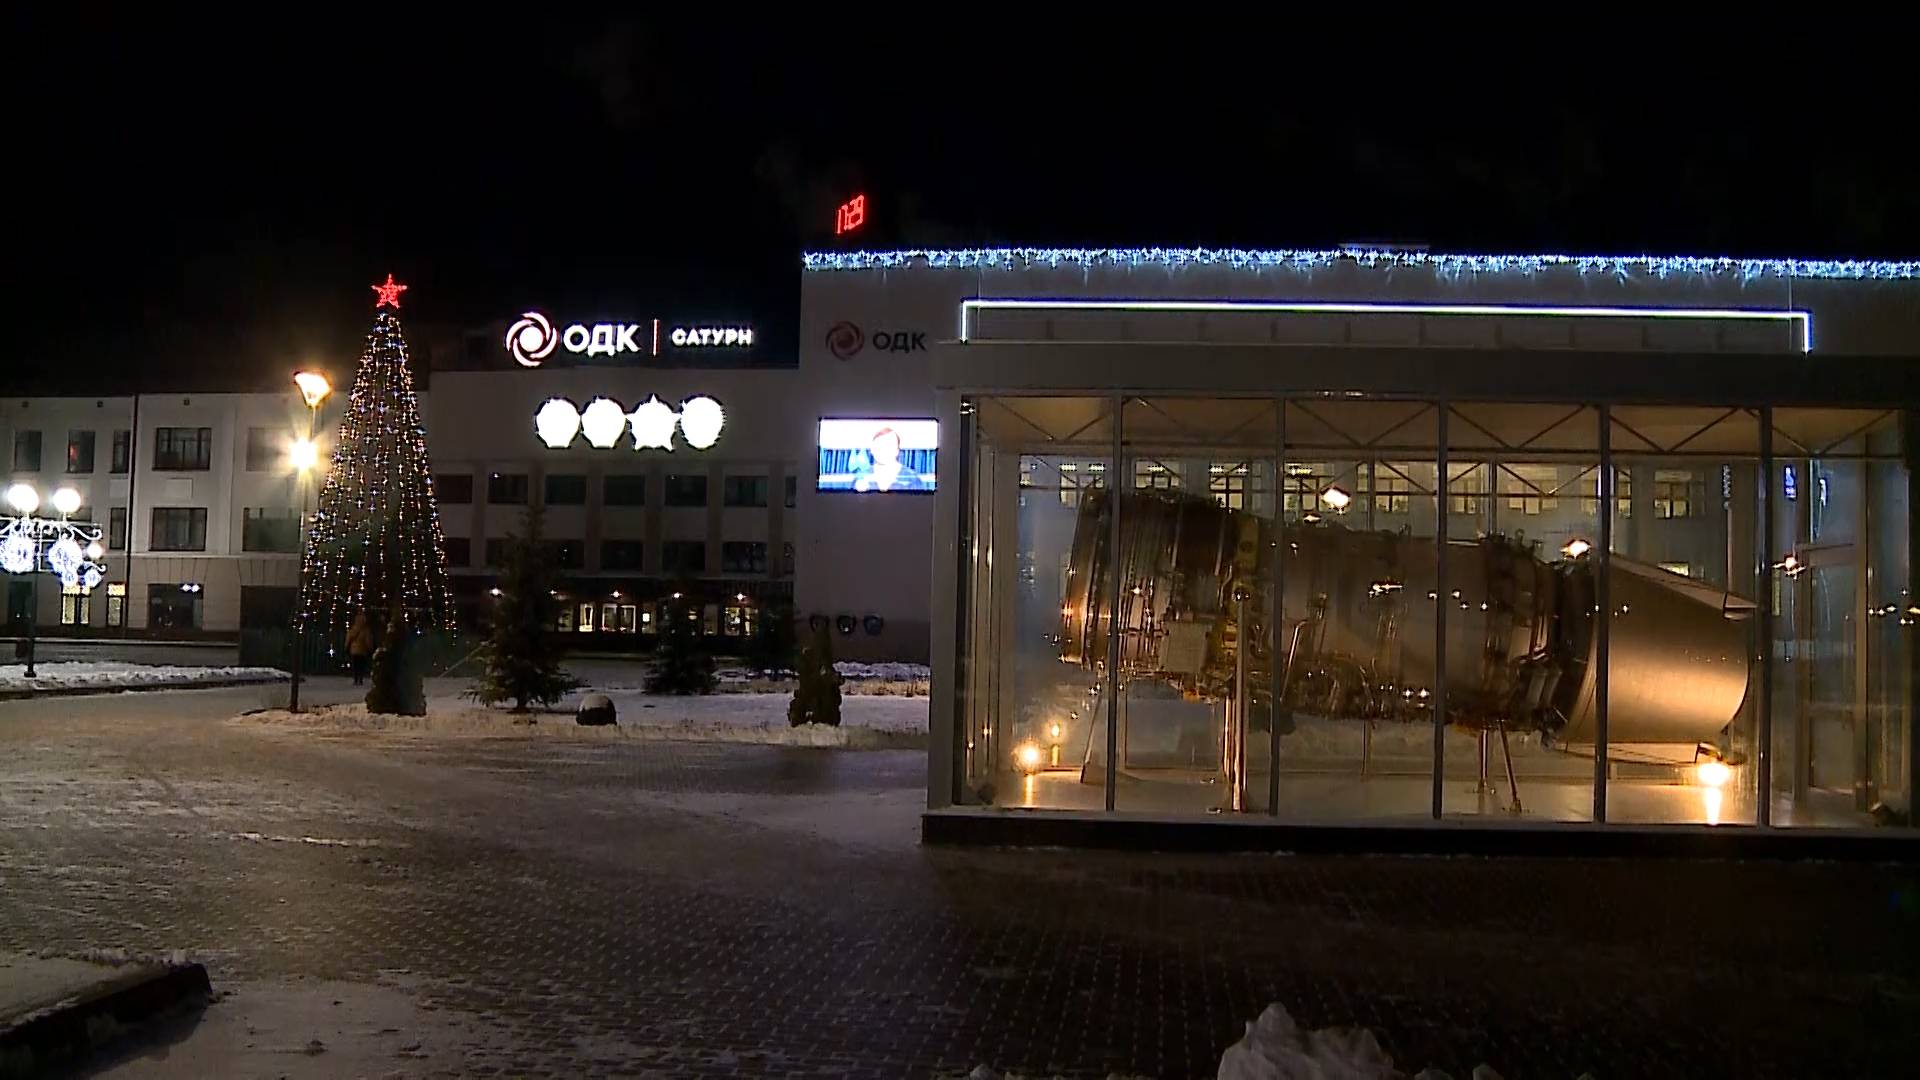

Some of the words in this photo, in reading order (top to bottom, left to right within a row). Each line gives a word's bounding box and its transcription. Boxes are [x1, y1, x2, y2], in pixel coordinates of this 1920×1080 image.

[563, 324, 641, 357] ОДК
[671, 327, 752, 346] САТУРН
[872, 331, 928, 353] ОДК
